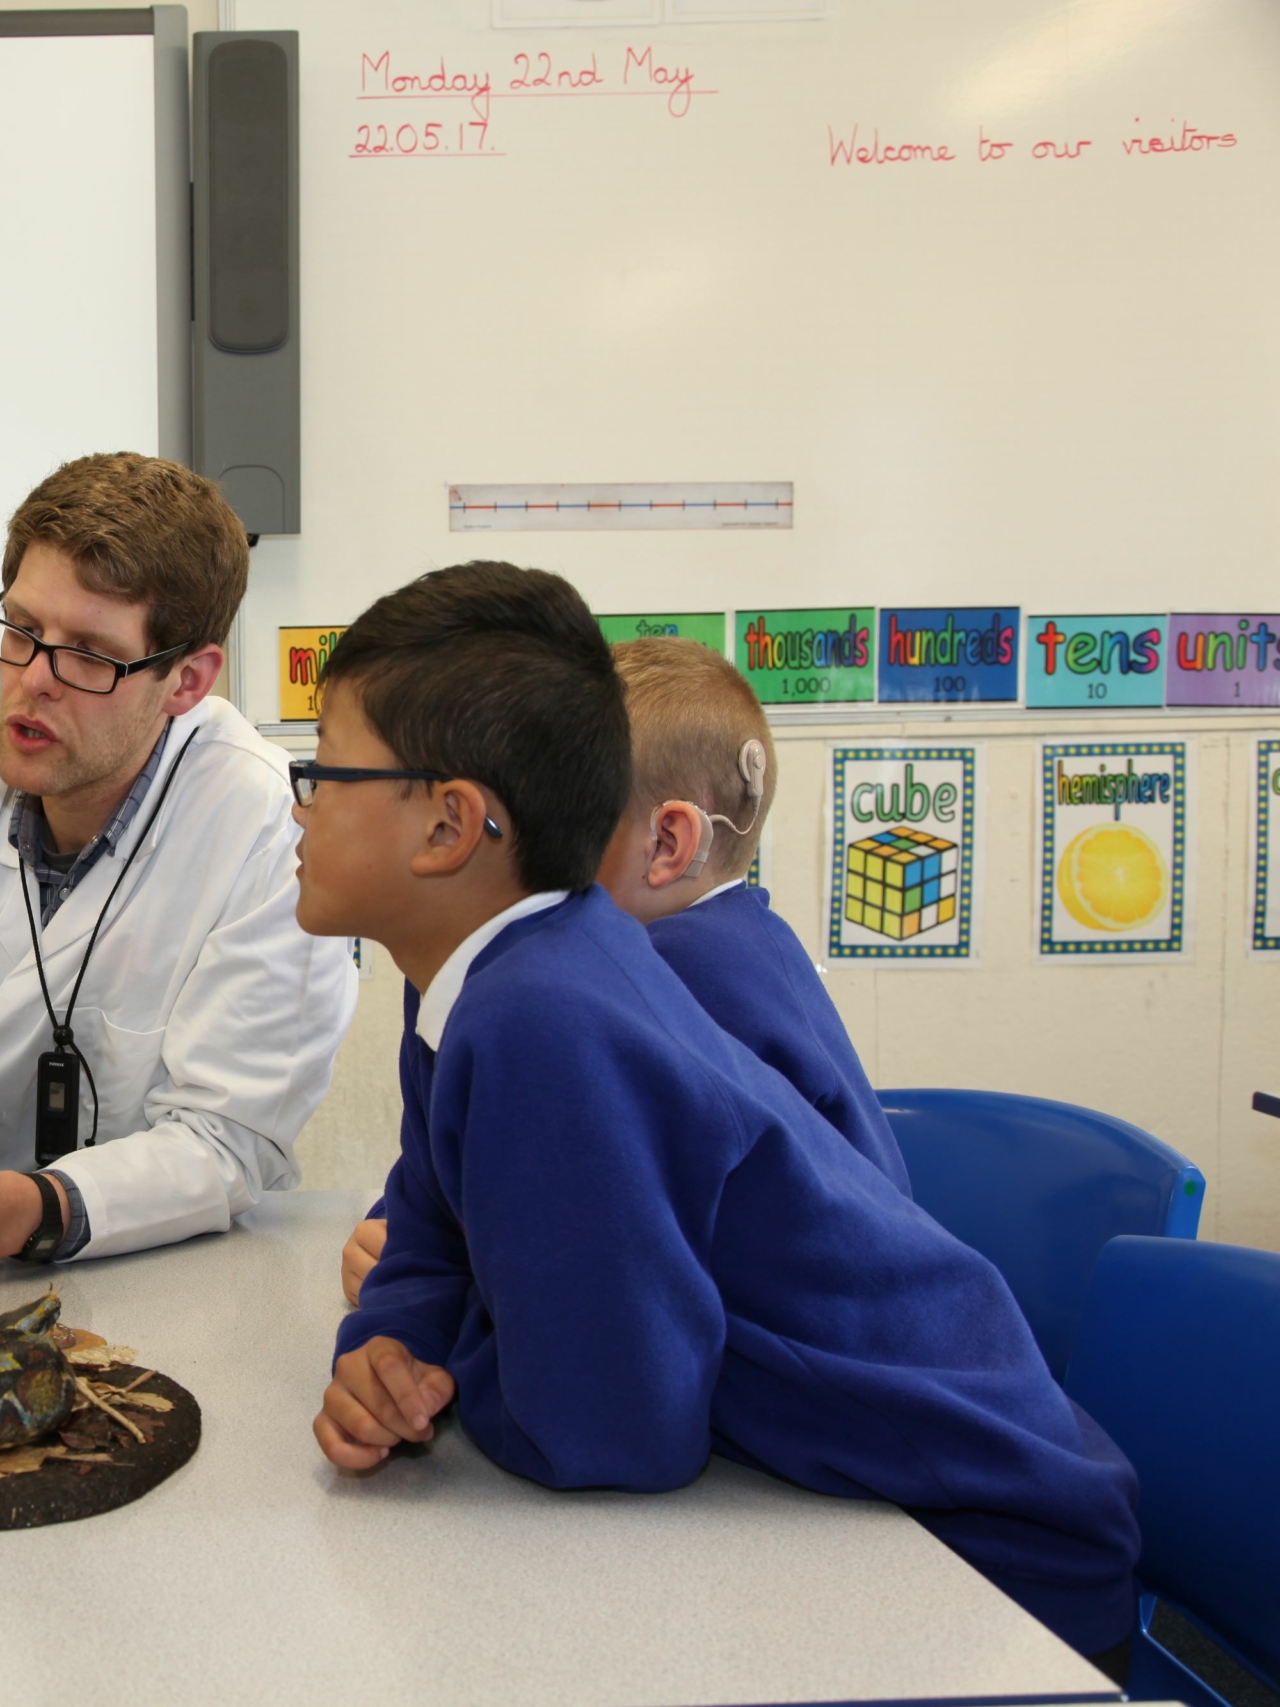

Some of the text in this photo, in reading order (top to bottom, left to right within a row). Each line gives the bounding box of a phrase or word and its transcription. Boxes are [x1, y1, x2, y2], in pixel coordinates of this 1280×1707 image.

[362, 46, 695, 122] Monday 22nd May
[827, 117, 1238, 166] Welcome to our visitors
[744, 614, 870, 672] thousands
[888, 613, 1015, 667] hundreds
[1036, 620, 1162, 676] tens
[781, 676, 831, 697] 1,000
[933, 675, 967, 694] 100
[1087, 681, 1107, 699] 10
[1234, 681, 1241, 698] 1
[850, 762, 959, 824] cube
[1056, 758, 1172, 822] hemisphere
